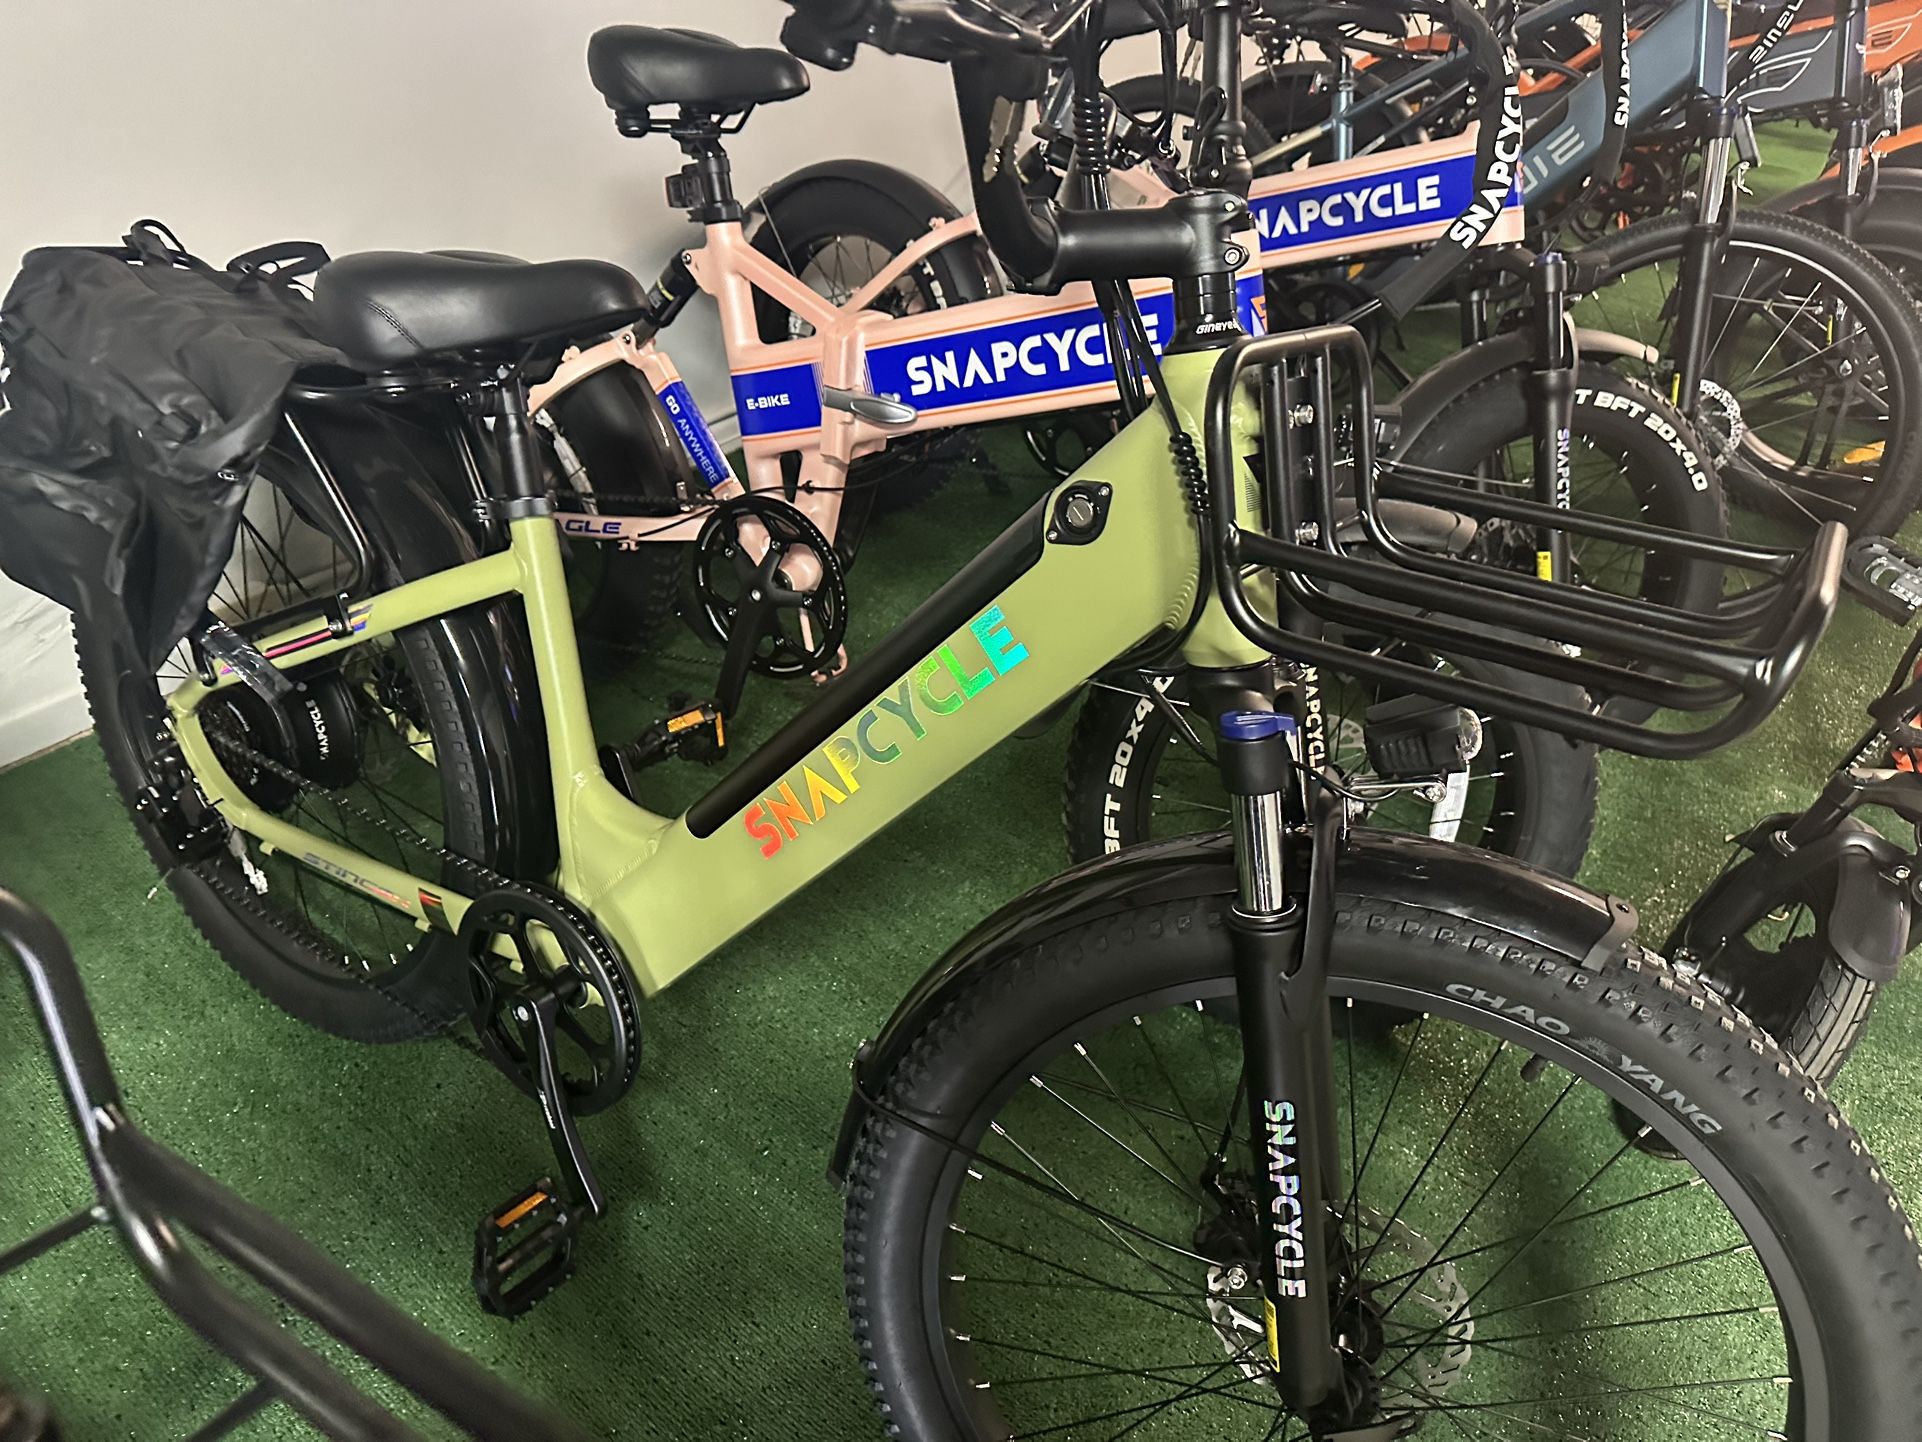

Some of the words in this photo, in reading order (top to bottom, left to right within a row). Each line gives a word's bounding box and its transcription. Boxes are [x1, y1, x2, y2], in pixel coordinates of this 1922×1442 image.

[1256, 174, 1441, 239] NAPCYCLE
[665, 395, 681, 415] GO
[677, 418, 720, 484] ANYWHERE
[1593, 391, 1647, 419] BFT
[742, 604, 1030, 860] SNAPCYCLE
[1445, 983, 1570, 1036] CHAO
[1617, 1054, 1723, 1135] YANG
[1264, 1100, 1307, 1298] SNAPCYCLE
